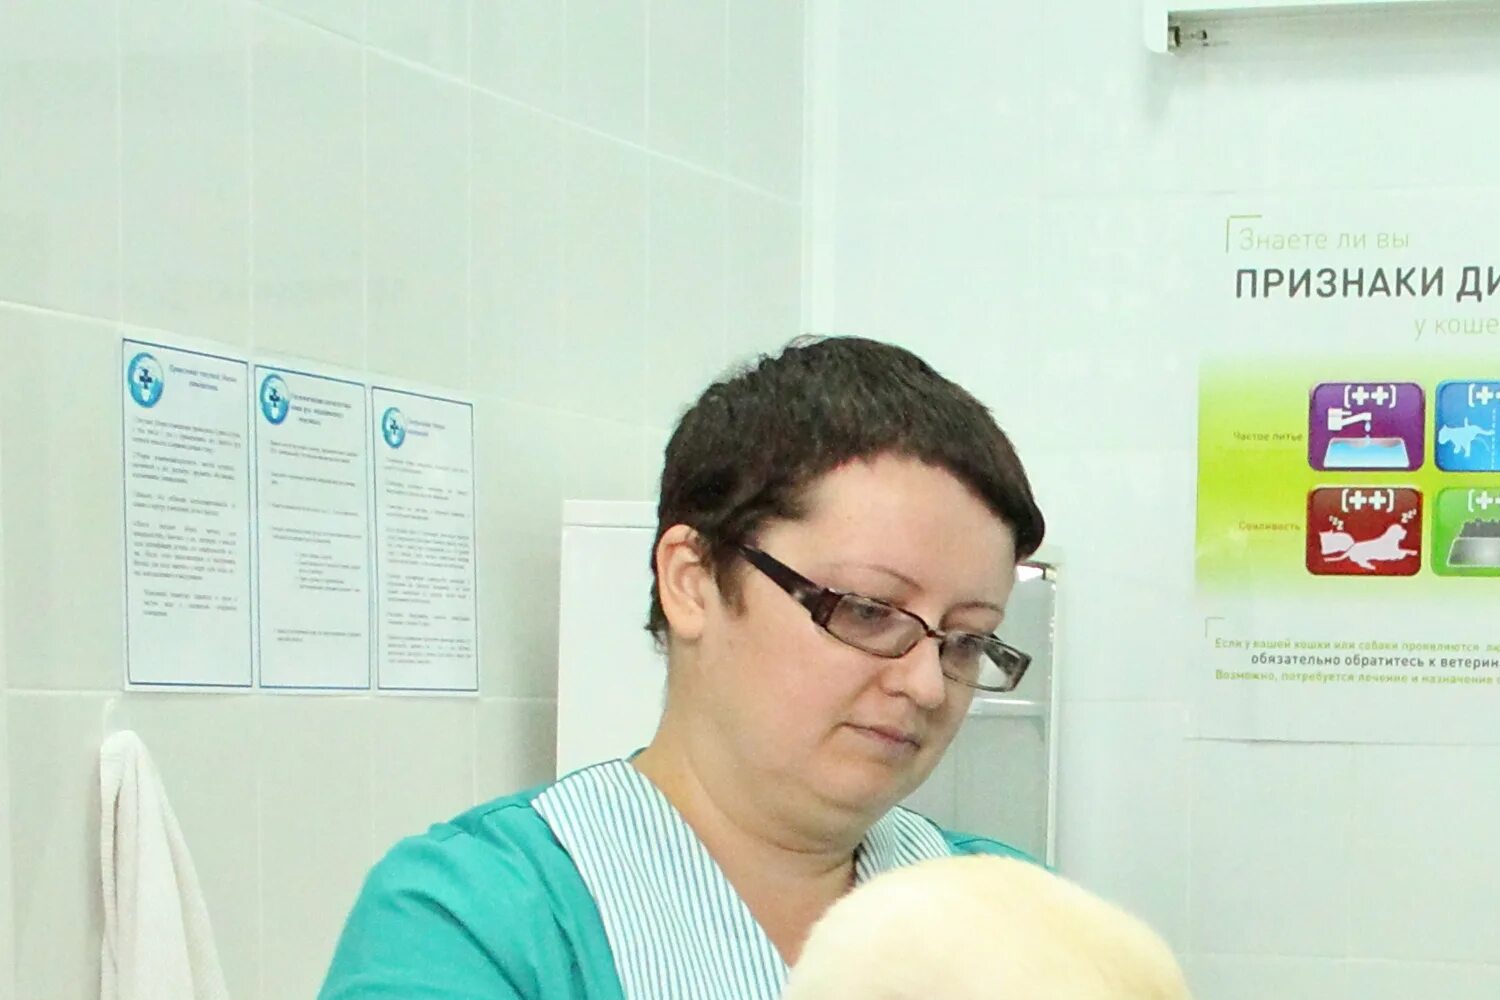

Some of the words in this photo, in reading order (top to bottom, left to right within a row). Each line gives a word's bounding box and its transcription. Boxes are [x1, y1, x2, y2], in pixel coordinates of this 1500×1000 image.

[1238, 226, 1328, 252] Знаете
[1336, 229, 1368, 250] ли
[1376, 228, 1410, 250] вы
[1234, 266, 1445, 300] ПРИЗНАКИ
[1413, 316, 1428, 341] у
[1251, 653, 1341, 666] обязательно
[1344, 654, 1425, 669] обратитесь
[1428, 657, 1436, 667] к
